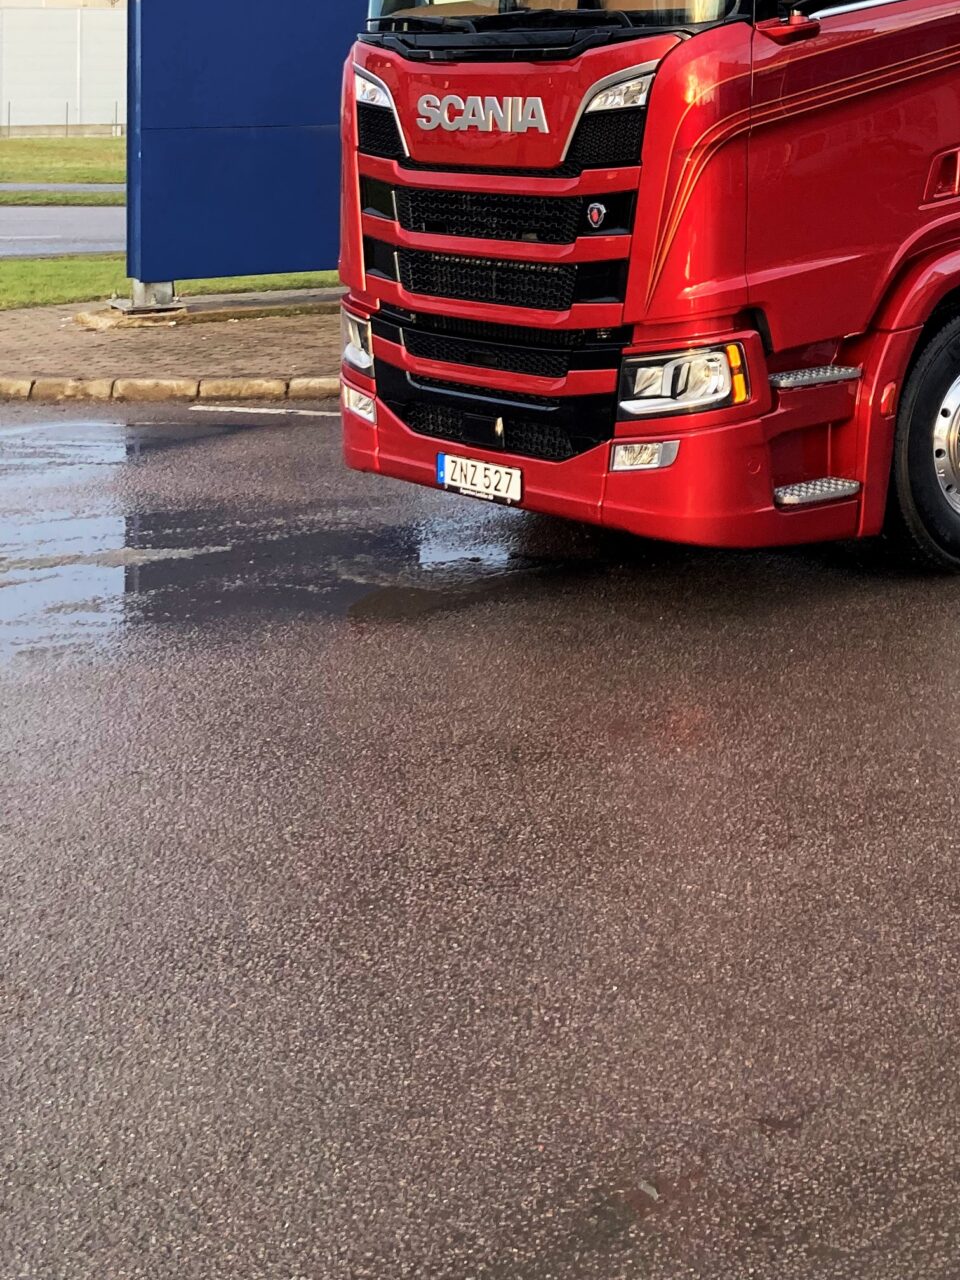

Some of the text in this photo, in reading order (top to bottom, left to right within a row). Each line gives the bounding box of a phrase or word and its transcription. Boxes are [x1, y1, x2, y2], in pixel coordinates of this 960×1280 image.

[416, 94, 550, 134] SCANIA
[450, 459, 478, 487] ZNZ
[483, 466, 513, 494] 527
